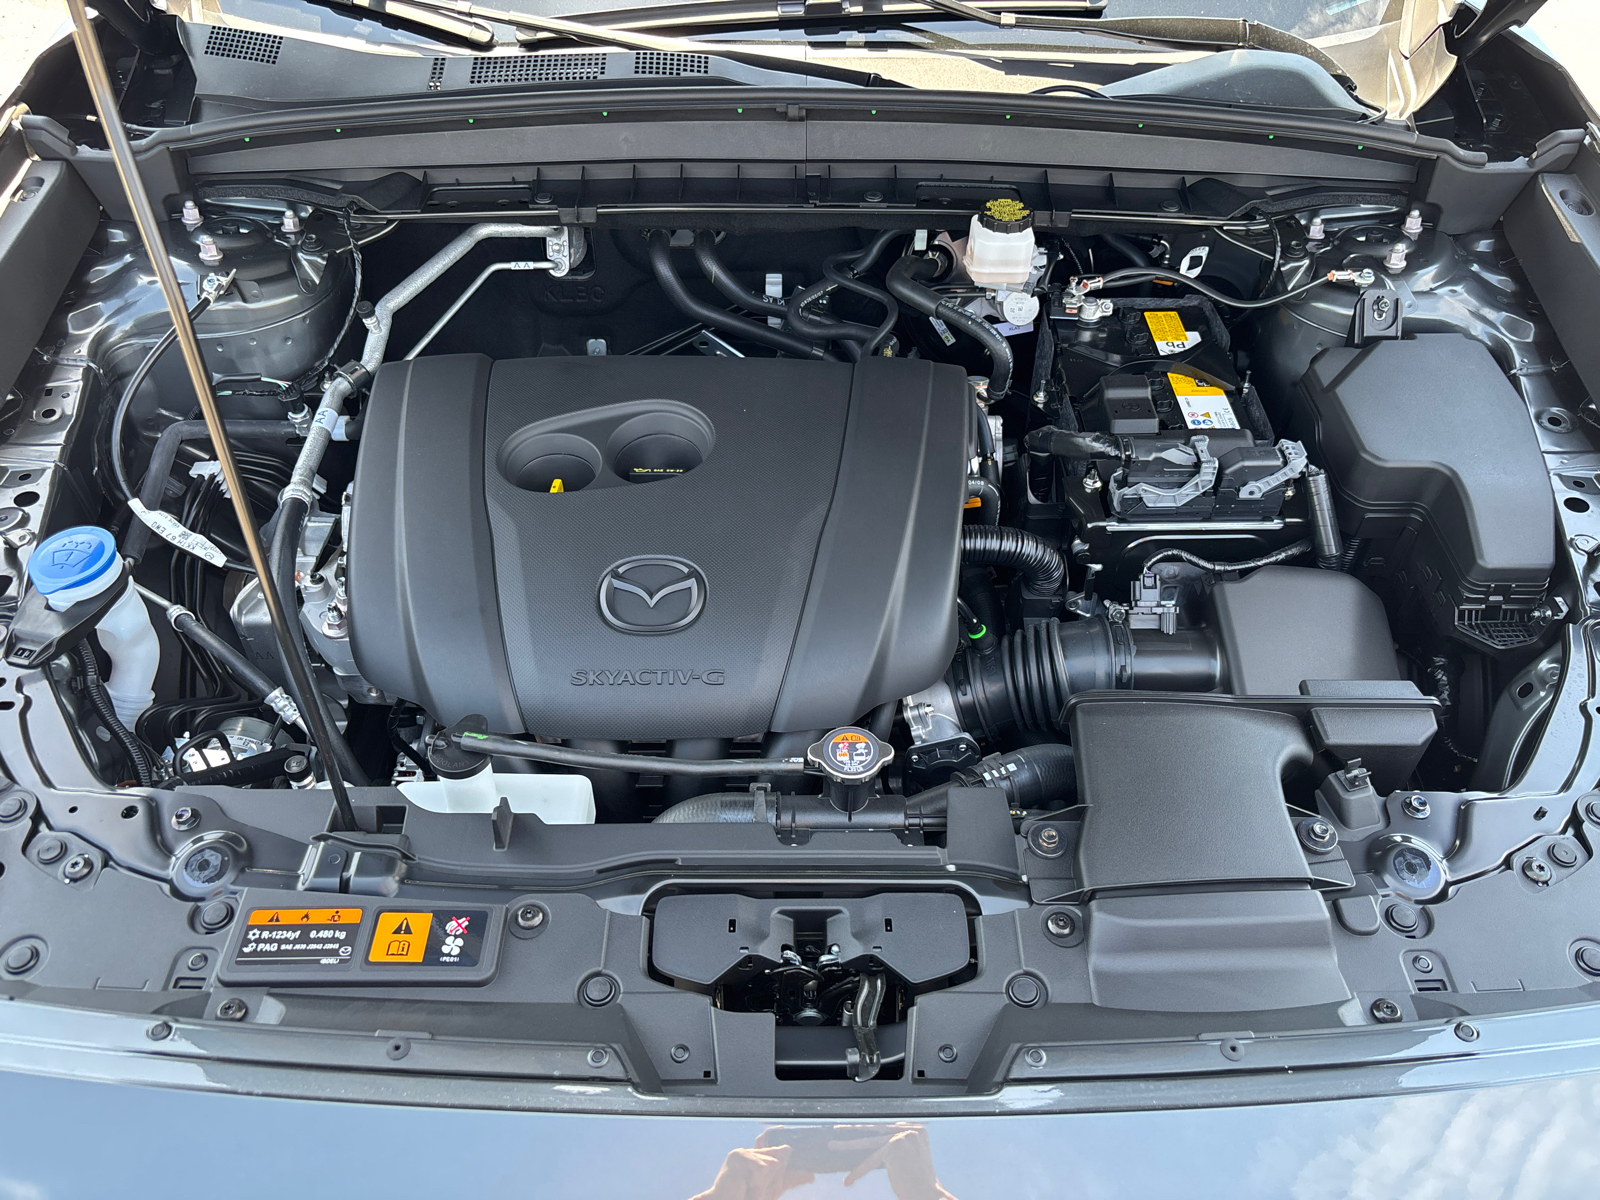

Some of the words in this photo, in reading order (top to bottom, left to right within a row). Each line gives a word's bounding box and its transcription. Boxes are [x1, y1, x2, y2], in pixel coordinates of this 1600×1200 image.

[1166, 341, 1186, 349] Pb
[315, 410, 328, 425] AA
[166, 533, 177, 542] 67
[571, 669, 725, 686] SKYACTIV-G
[261, 930, 302, 940] R-1234yf
[309, 930, 334, 939] 0.480
[334, 930, 347, 940] kg
[257, 943, 278, 952] PAG
